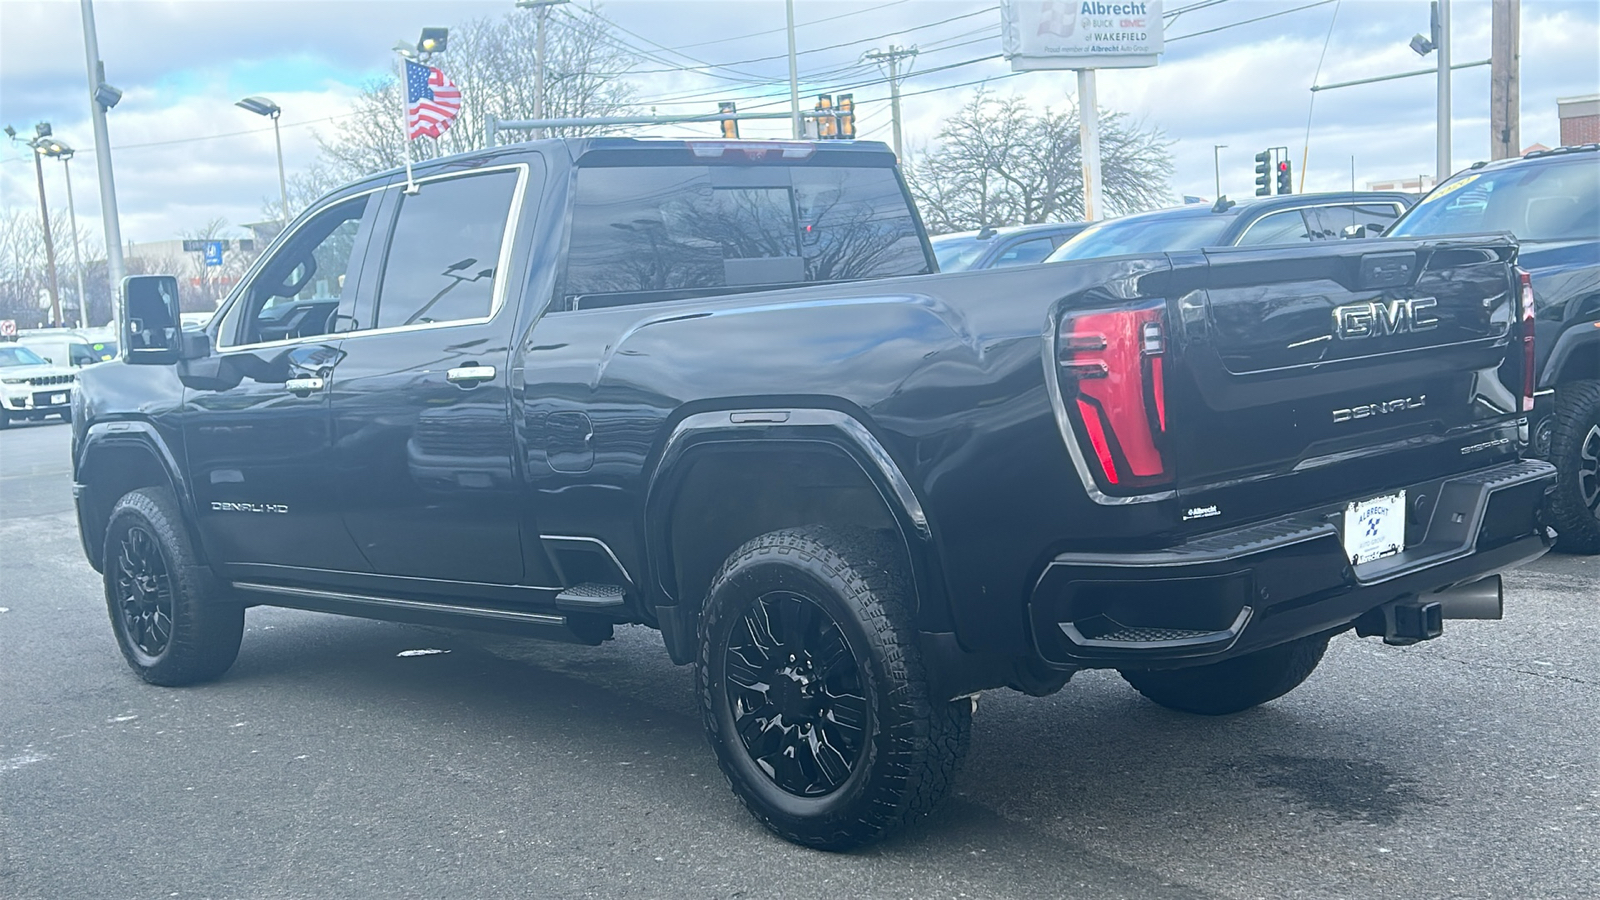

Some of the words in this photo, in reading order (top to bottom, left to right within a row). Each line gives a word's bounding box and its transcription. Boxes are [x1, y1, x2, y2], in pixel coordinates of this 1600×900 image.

[1081, 1, 1147, 15] Albrecht
[1093, 19, 1113, 28] BUICK
[1119, 19, 1146, 28] GMC
[1095, 32, 1147, 42] WAKEFIELD
[1332, 297, 1438, 340] GMC
[1333, 395, 1426, 423] DENALI
[211, 502, 264, 513] DENALI
[266, 504, 288, 513] HD
[1358, 506, 1389, 525] ALBRECHT
